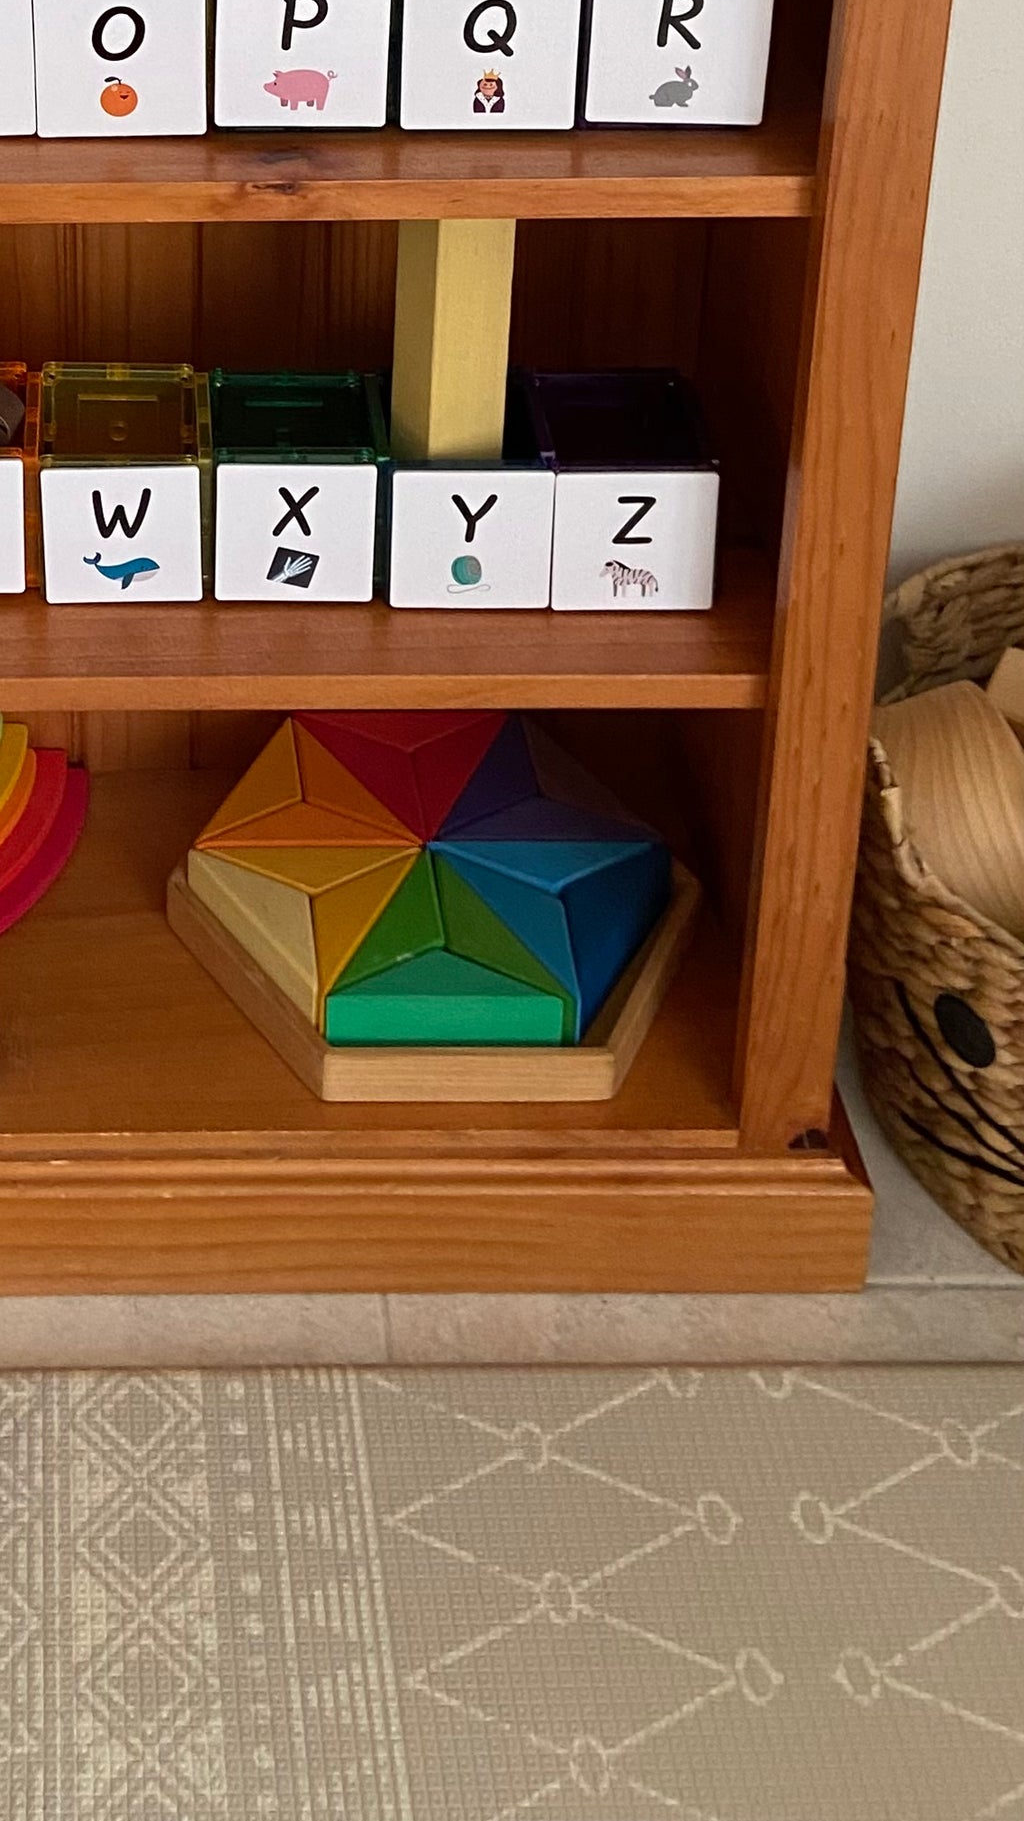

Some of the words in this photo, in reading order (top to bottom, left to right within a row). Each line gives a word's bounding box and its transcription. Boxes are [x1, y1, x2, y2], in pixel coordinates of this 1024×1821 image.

[91, 5, 146, 62] O
[91, 487, 152, 539] W
[272, 486, 320, 537] X
[451, 494, 498, 543] Y
[611, 495, 657, 545] Z
